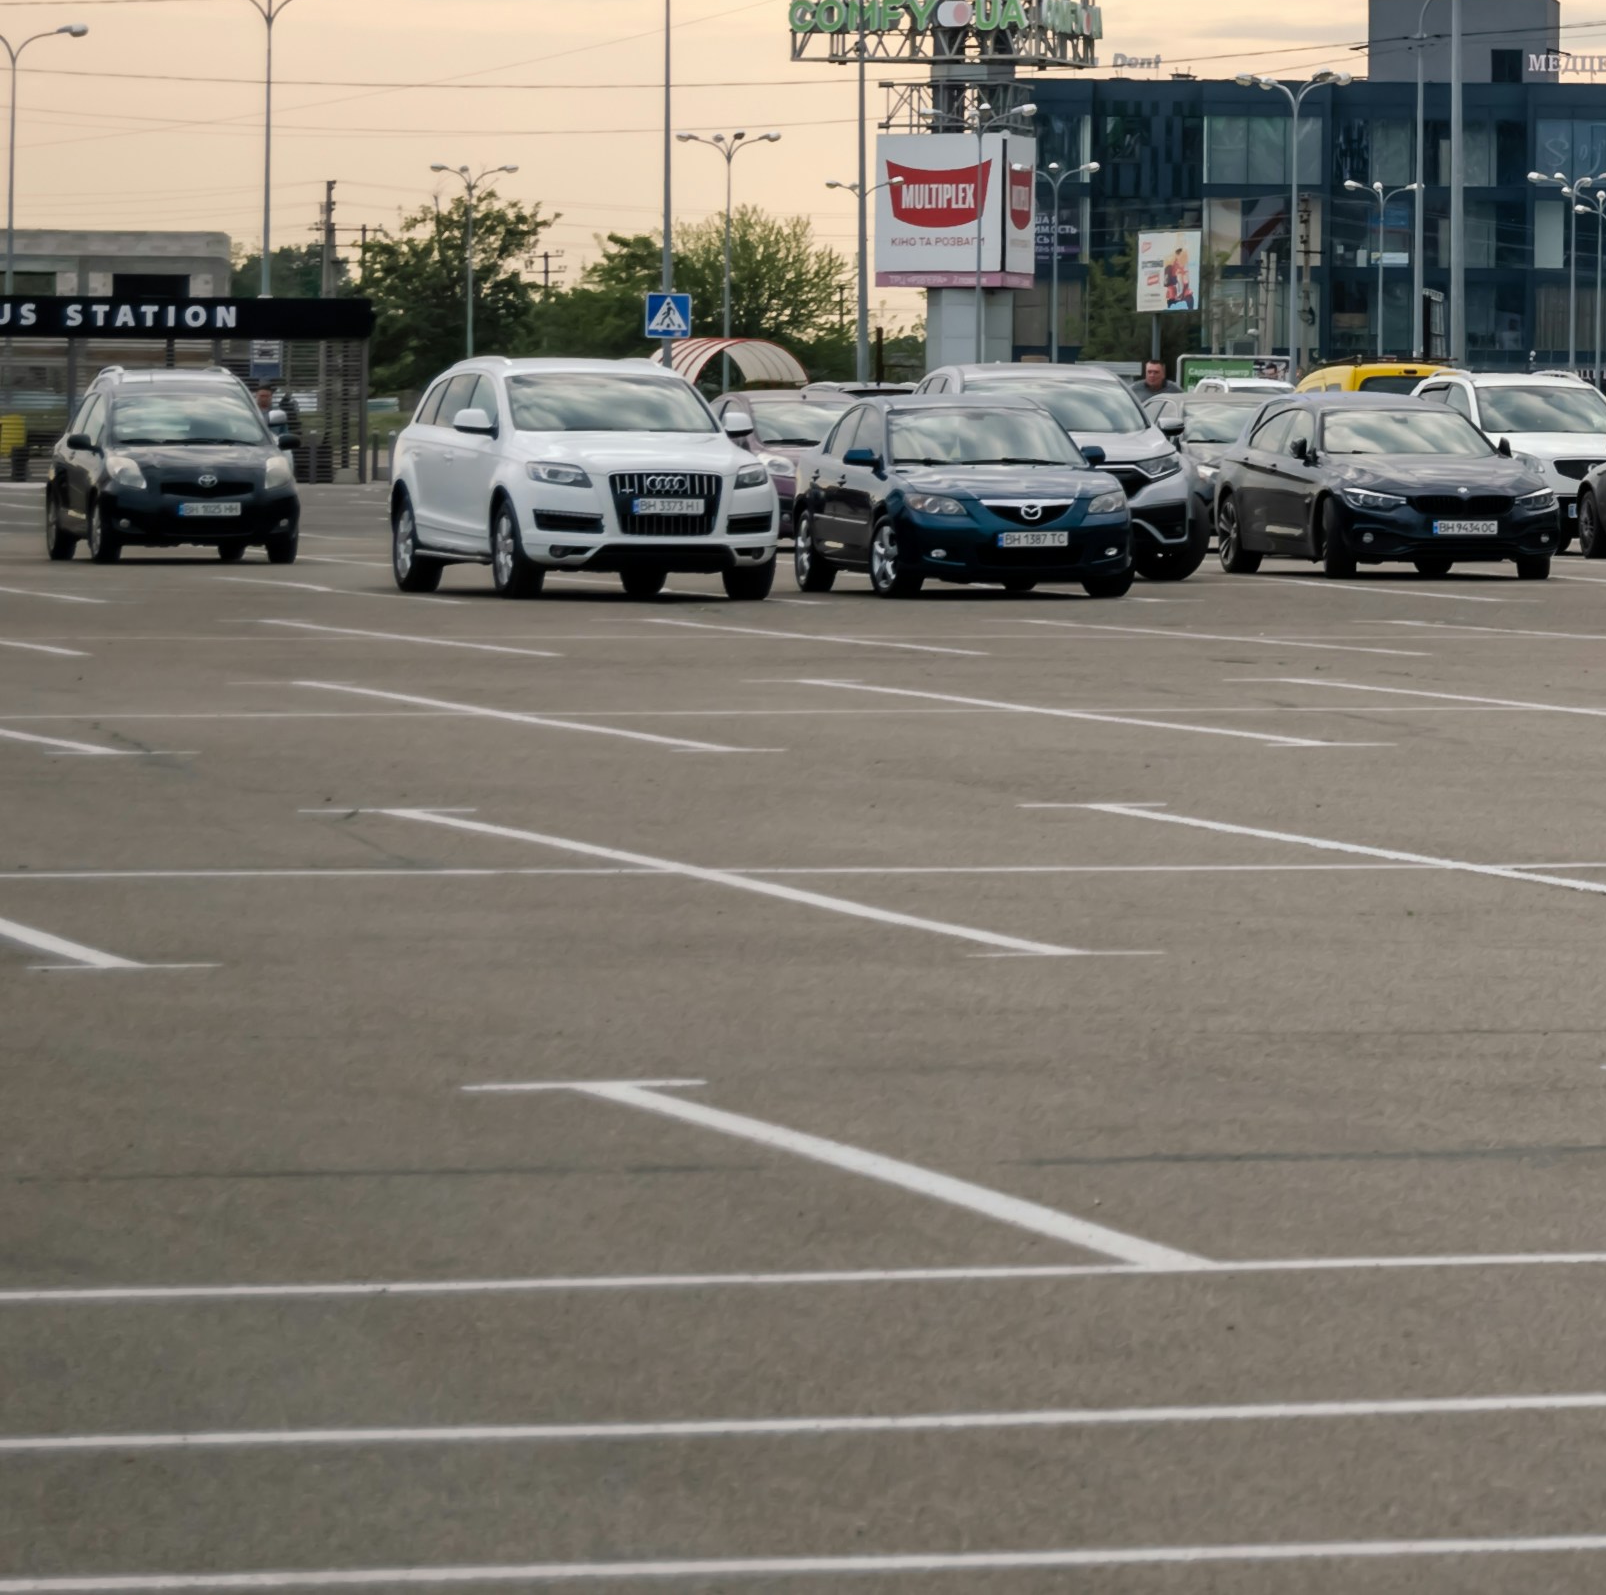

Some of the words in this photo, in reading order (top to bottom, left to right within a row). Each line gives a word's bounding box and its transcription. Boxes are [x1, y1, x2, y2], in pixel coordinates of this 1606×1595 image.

[1112, 53, 1161, 68] Dent
[902, 183, 974, 209] MULTIPLEX
[891, 236, 917, 247] КІНО
[919, 236, 932, 246] ТА
[66, 305, 237, 327] STATION
[1005, 534, 1021, 545] BH
